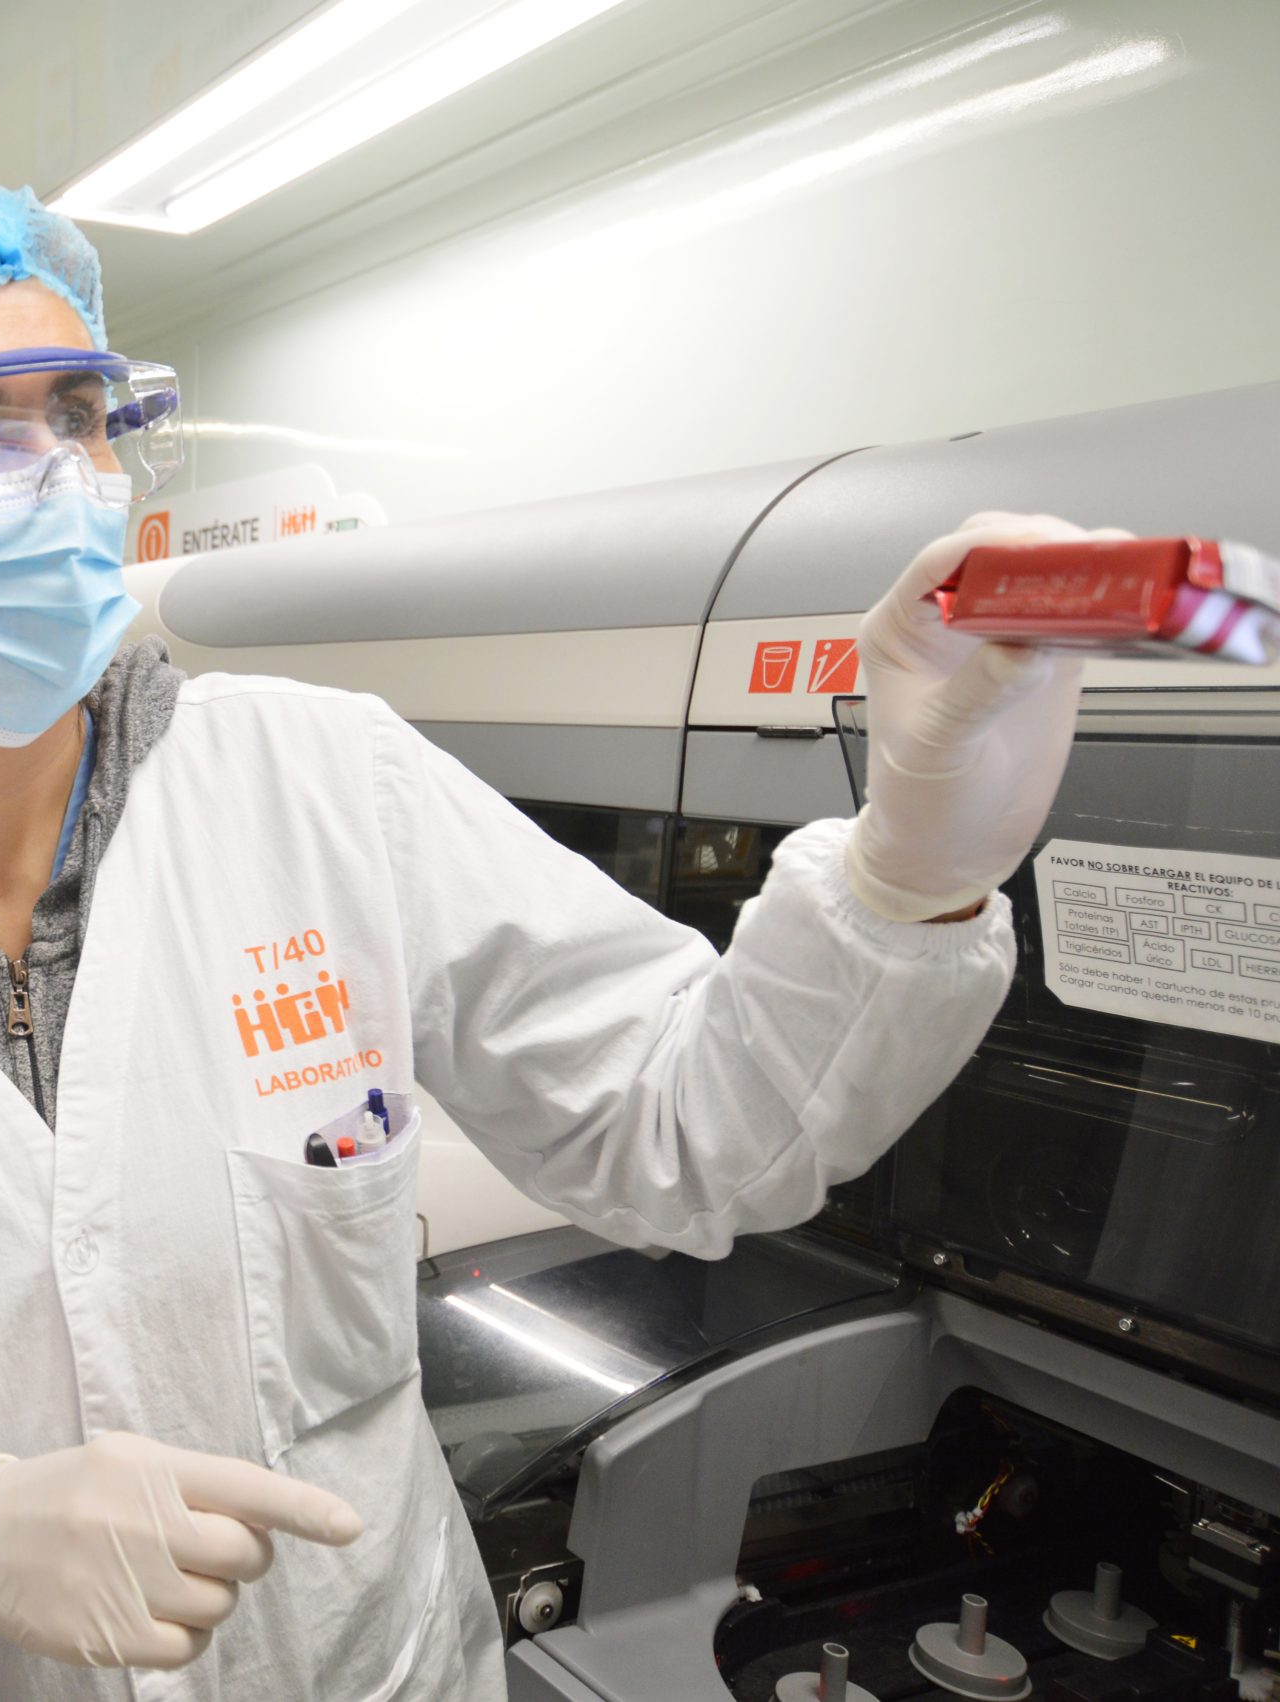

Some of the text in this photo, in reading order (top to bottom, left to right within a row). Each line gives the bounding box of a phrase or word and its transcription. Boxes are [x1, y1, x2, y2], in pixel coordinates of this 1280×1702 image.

[183, 518, 260, 555] ENTÉRATE
[1050, 856, 1085, 867] FAVOR
[1087, 860, 1103, 870] NO
[1106, 863, 1140, 874] SOBRE
[1143, 866, 1192, 880] CARGAR
[1195, 872, 1206, 881] EL
[1209, 874, 1254, 887] EQUIPO
[1257, 878, 1273, 889] DE
[1063, 887, 1097, 900] Calcio
[1167, 881, 1234, 897] REACTIVOS:
[1205, 904, 1223, 915] CK
[1064, 920, 1120, 938] Totales (TP)
[1140, 919, 1159, 930] AST
[1143, 938, 1175, 953] Ácido
[1202, 957, 1222, 969] LDL
[1246, 961, 1280, 976] HIERR
[1059, 962, 1080, 974] Sólo
[1081, 967, 1110, 979] debe
[1112, 971, 1144, 985] haber
[1155, 980, 1206, 996] cartucho
[1209, 988, 1225, 999] de
[1228, 993, 1258, 1005] estas
[1059, 974, 1094, 988] Cargar
[1097, 982, 1138, 996] cuando
[1141, 990, 1184, 1005] queden
[1186, 998, 1225, 1012] menos
[1228, 1004, 1244, 1015] de
[1249, 1007, 1261, 1019] 10
[255, 1049, 383, 1097] LABORATIO
